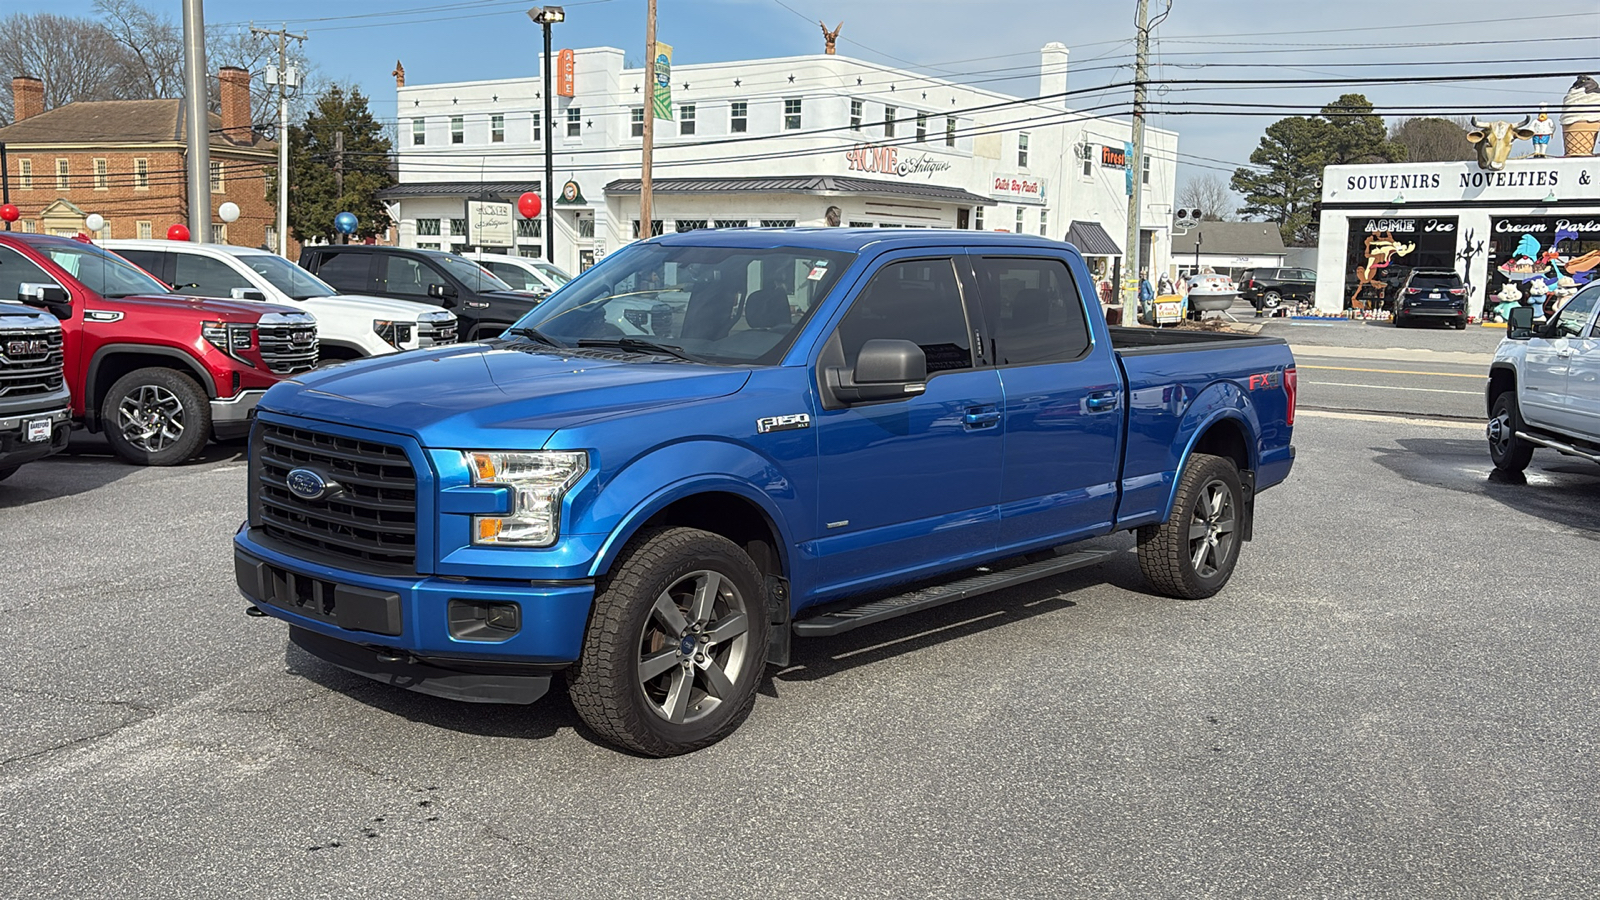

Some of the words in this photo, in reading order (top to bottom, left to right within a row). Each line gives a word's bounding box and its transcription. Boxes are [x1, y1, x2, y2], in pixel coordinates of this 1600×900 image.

[565, 52, 573, 93] ACME
[846, 143, 898, 175] ACME
[898, 153, 951, 178] Antiques
[995, 178, 1010, 191] Dutch
[1011, 179, 1021, 194] Boy
[1022, 180, 1038, 193] Paints
[1347, 173, 1440, 190] SOUVENIRS
[1459, 171, 1558, 188] NOVELTIES
[1578, 170, 1591, 185] &
[1364, 219, 1415, 232] ACME
[1424, 219, 1455, 232] Ice
[1495, 219, 1547, 233] Cream
[594, 248, 605, 257] 25
[8, 341, 48, 354] GMC
[1249, 372, 1278, 390] FX4
[30, 421, 49, 429] BAREFORD
[292, 474, 315, 493] Ford
